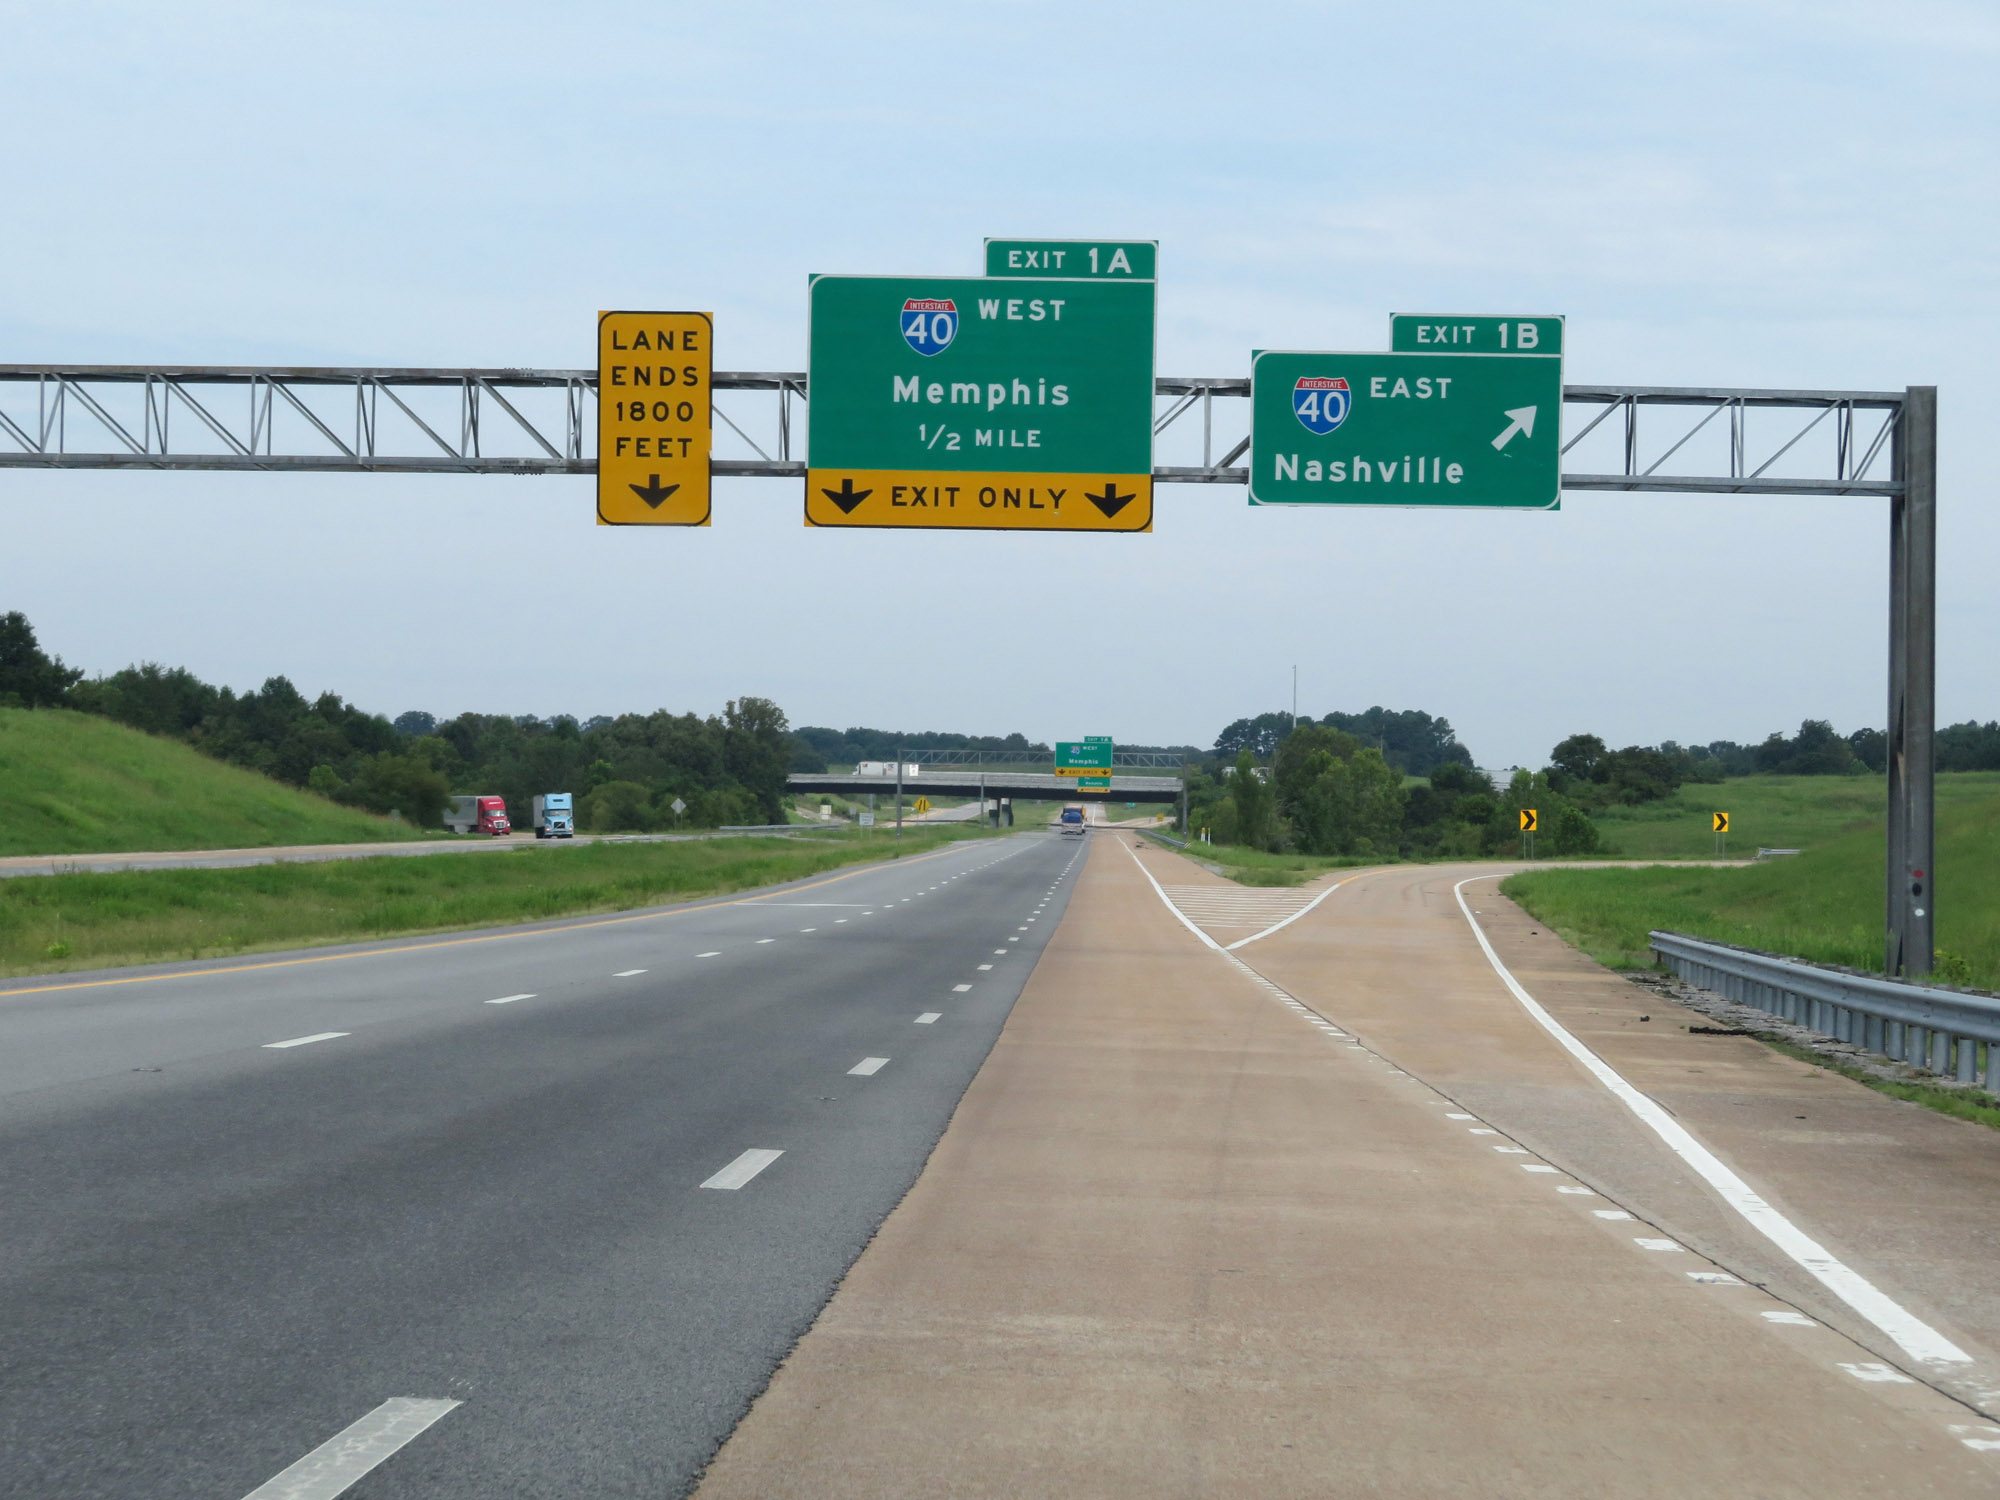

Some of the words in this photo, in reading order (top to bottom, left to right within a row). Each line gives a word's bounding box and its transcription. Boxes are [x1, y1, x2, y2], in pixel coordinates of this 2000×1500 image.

[1008, 250, 1066, 269] EXIT
[1089, 247, 1133, 274] 1A
[909, 302, 950, 311] INTERSTATE
[978, 299, 1066, 321] WEST
[612, 330, 698, 351] LANE
[904, 313, 953, 345] 40
[1417, 325, 1476, 344] EXIT
[1498, 322, 1539, 349] 1B
[611, 366, 698, 387] ENDS
[1301, 379, 1343, 389] INTERSTATE
[1370, 376, 1452, 399] EAST
[893, 375, 1070, 412] Memphis
[616, 401, 694, 422] 1800
[1296, 390, 1346, 423] 40
[616, 436, 693, 458] FEET
[919, 423, 961, 450] 1/2
[975, 429, 1041, 448] MILE
[1274, 453, 1464, 484] Nashville
[891, 485, 961, 508] EXIT
[978, 486, 1067, 509] ONLY
